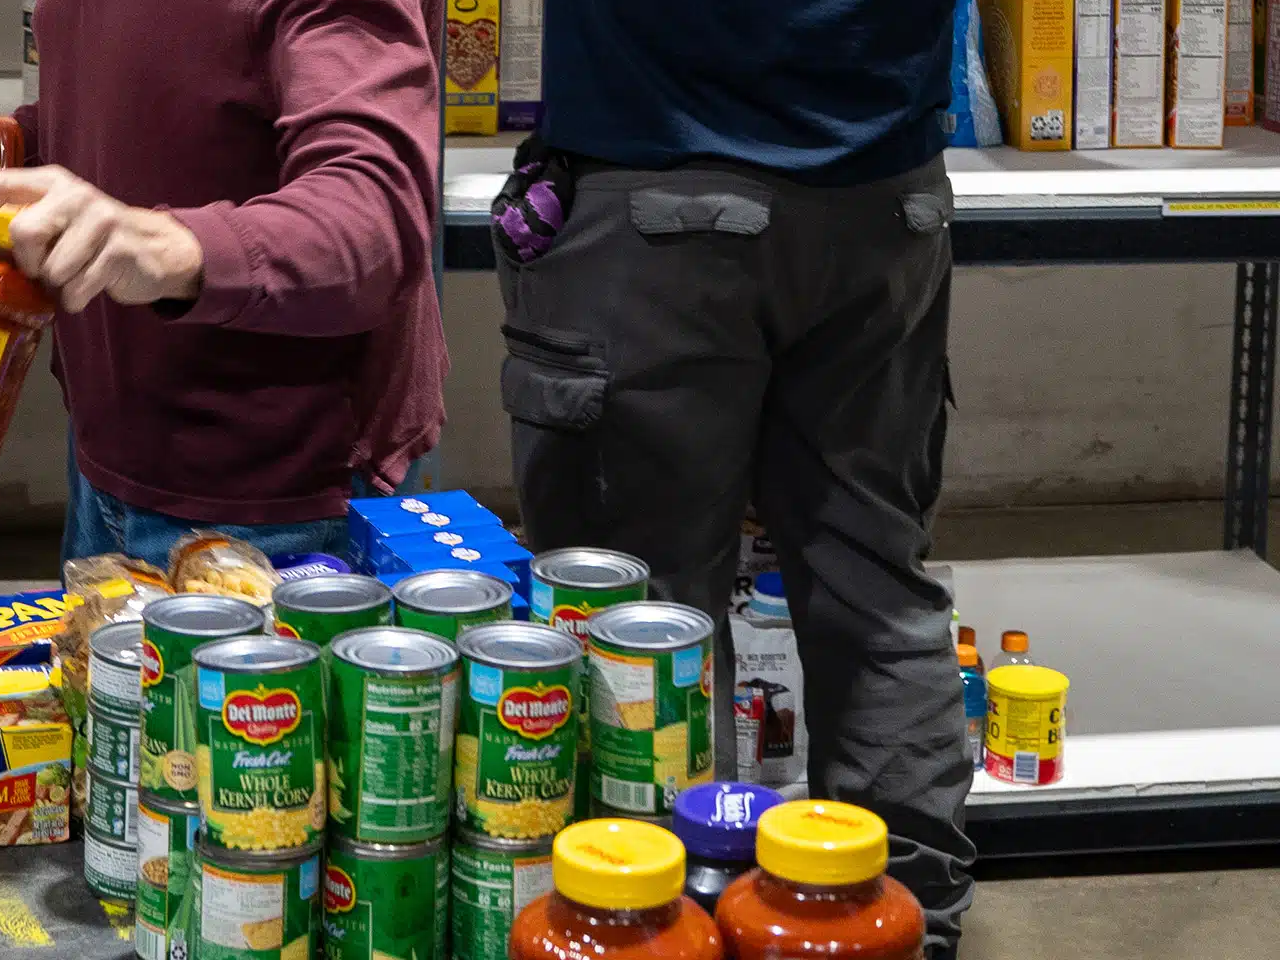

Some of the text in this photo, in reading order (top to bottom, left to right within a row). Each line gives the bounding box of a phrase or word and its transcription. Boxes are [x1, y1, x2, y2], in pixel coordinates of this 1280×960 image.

[367, 683, 441, 694] Nutrition Facts
[228, 703, 297, 722] Del Monte
[505, 698, 569, 717] Del Monte
[233, 750, 293, 768] Fresh Cut
[172, 763, 192, 771] NON
[483, 860, 511, 872] Facts
